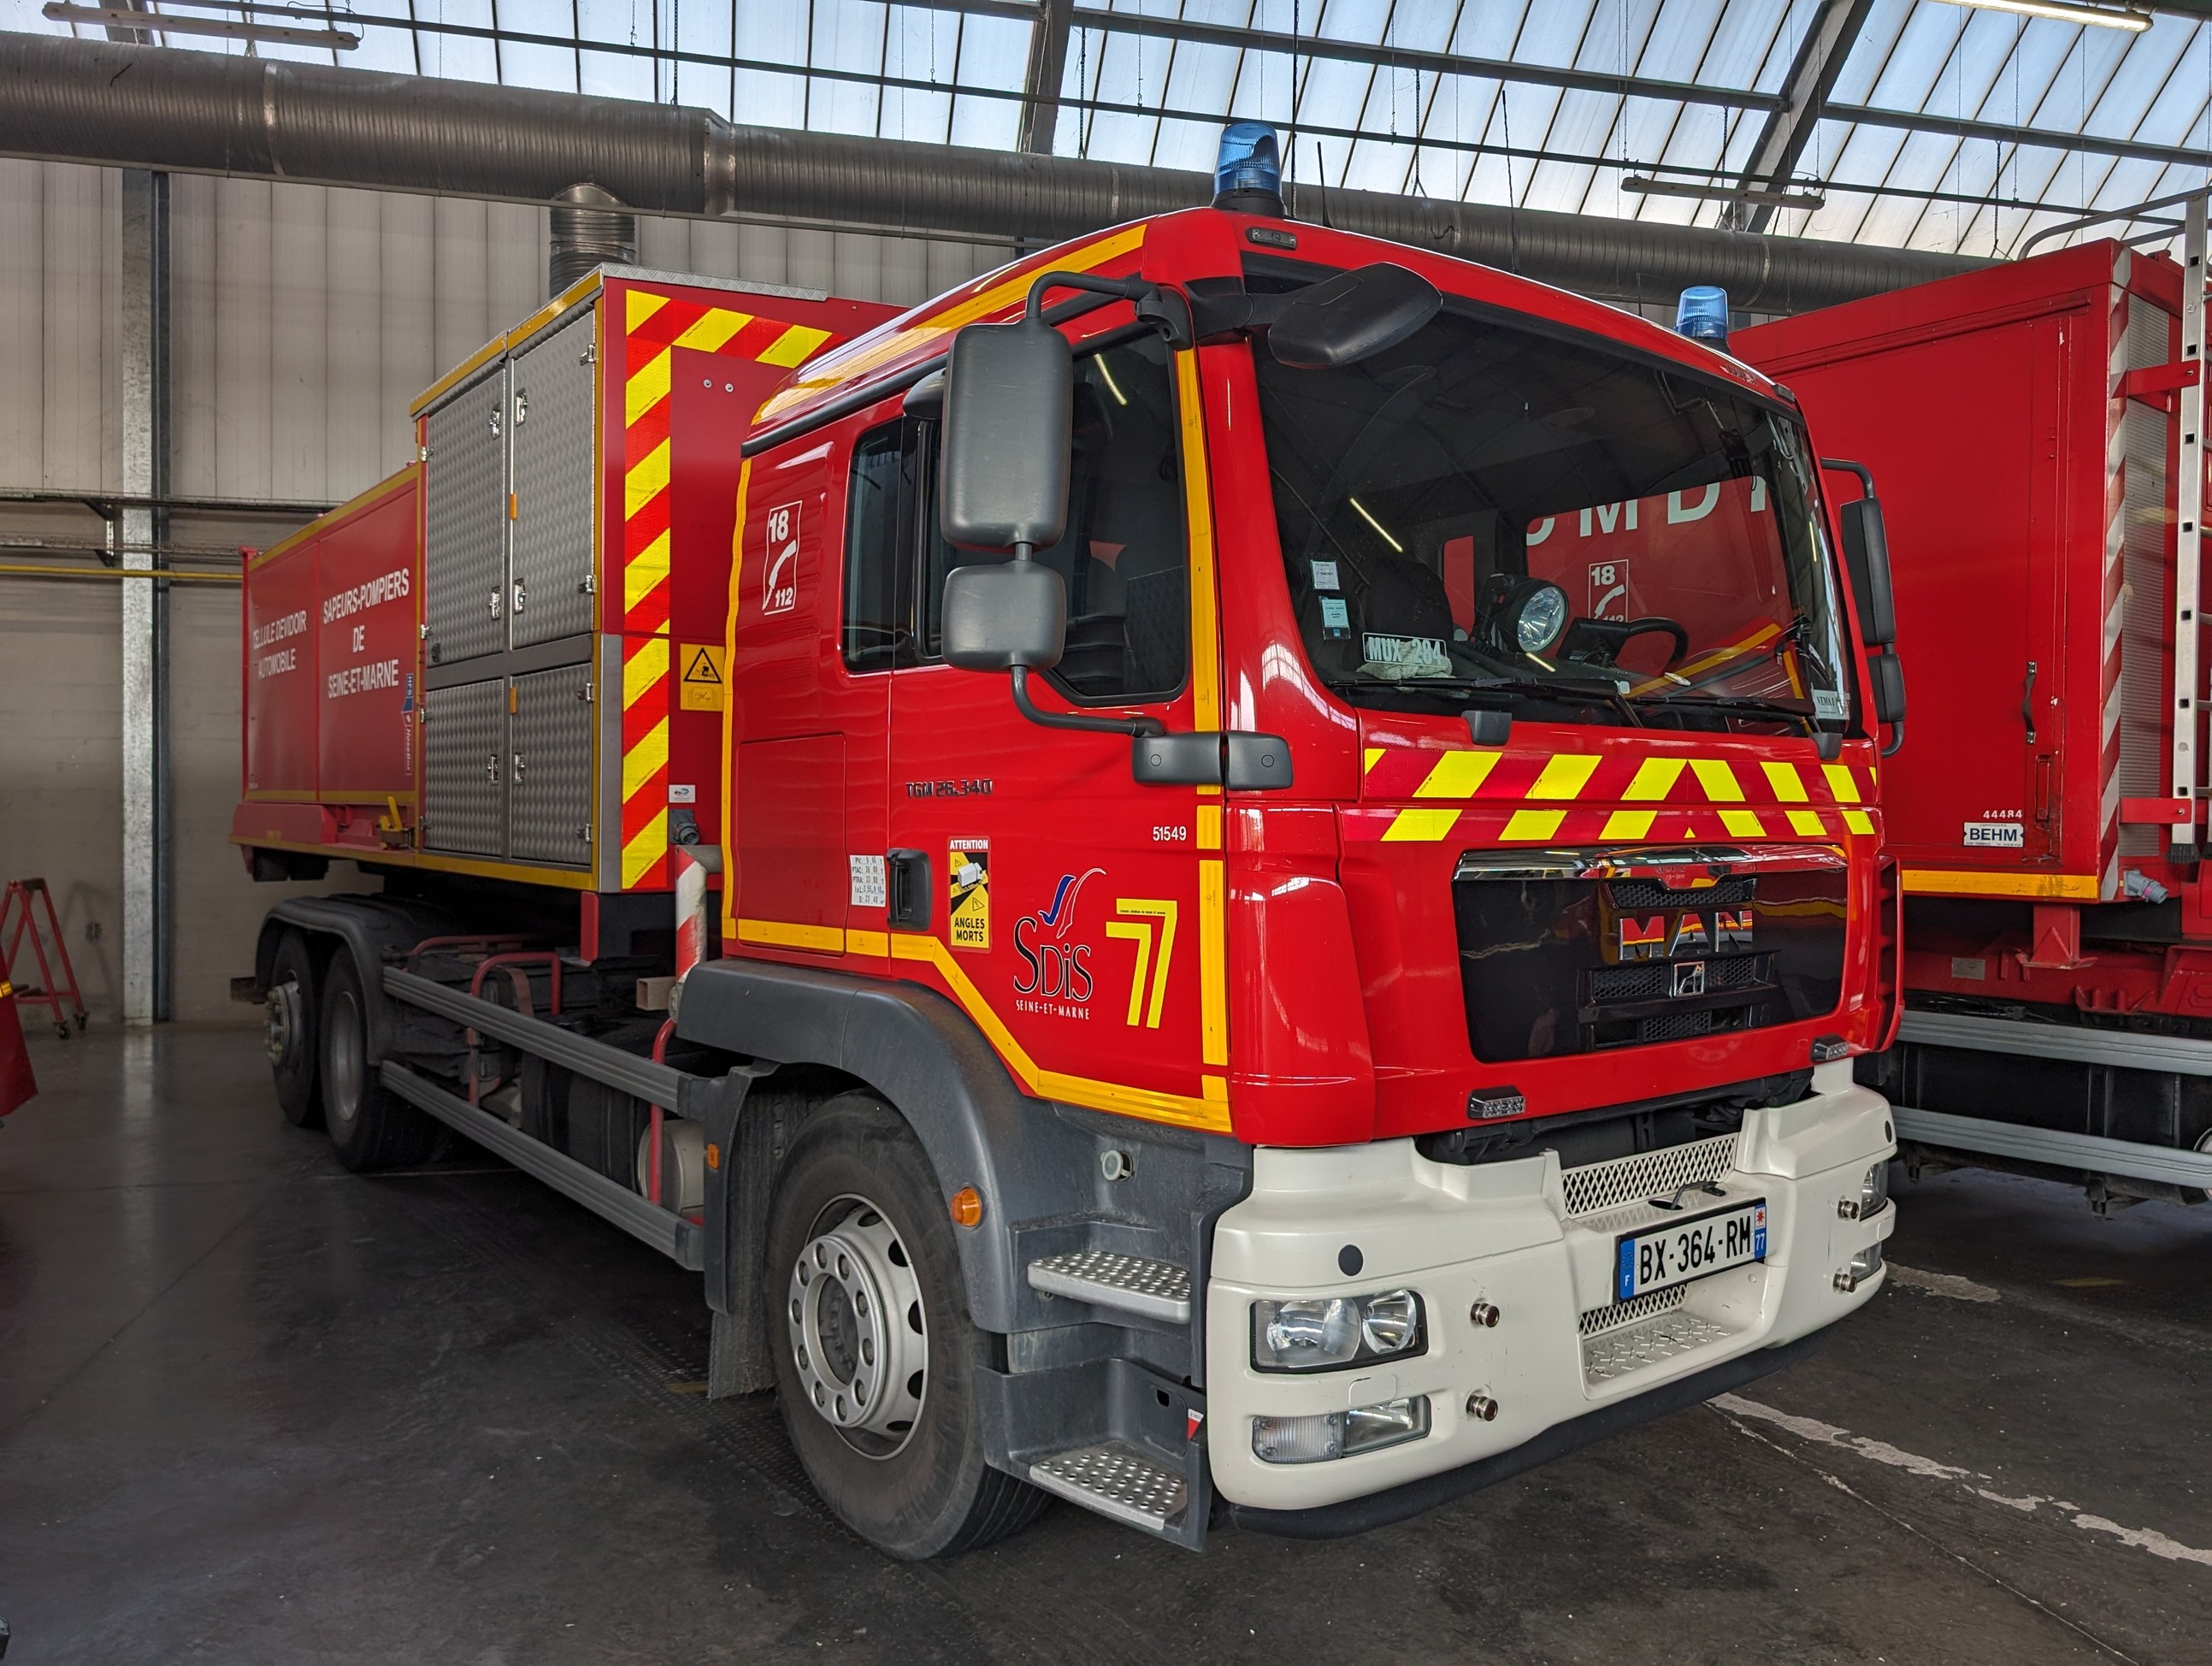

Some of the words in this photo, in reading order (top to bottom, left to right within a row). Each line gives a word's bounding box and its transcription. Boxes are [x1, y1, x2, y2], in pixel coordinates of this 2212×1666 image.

[770, 510, 789, 542] 18
[1591, 564, 1616, 586] 18
[323, 568, 410, 624] SAPEURS-POMPIERS
[776, 587, 793, 608] 112
[253, 622, 275, 650] CELLULE
[352, 625, 365, 653] DE
[1368, 636, 1402, 662] MUX
[1412, 637, 1442, 665] 284
[258, 648, 296, 680] AUTOMOBILE
[328, 659, 399, 699] SEINE-ET-MARNE
[906, 782, 934, 797] TGM
[1983, 809, 2022, 818] 44484
[950, 840, 988, 849] ATTENTION
[1153, 826, 1187, 842] 51549
[1969, 828, 2018, 842] BEHM
[954, 918, 985, 929] ANGLES
[956, 930, 984, 942] MORTS
[1619, 910, 1752, 960] MAN
[1106, 898, 1177, 1029] 77
[1016, 999, 1089, 1019] SEINE-ET-MARNE
[1640, 1215, 1750, 1285] BX-364-RM
[1755, 1232, 1765, 1251] 77
[1625, 1274, 1630, 1286] F
